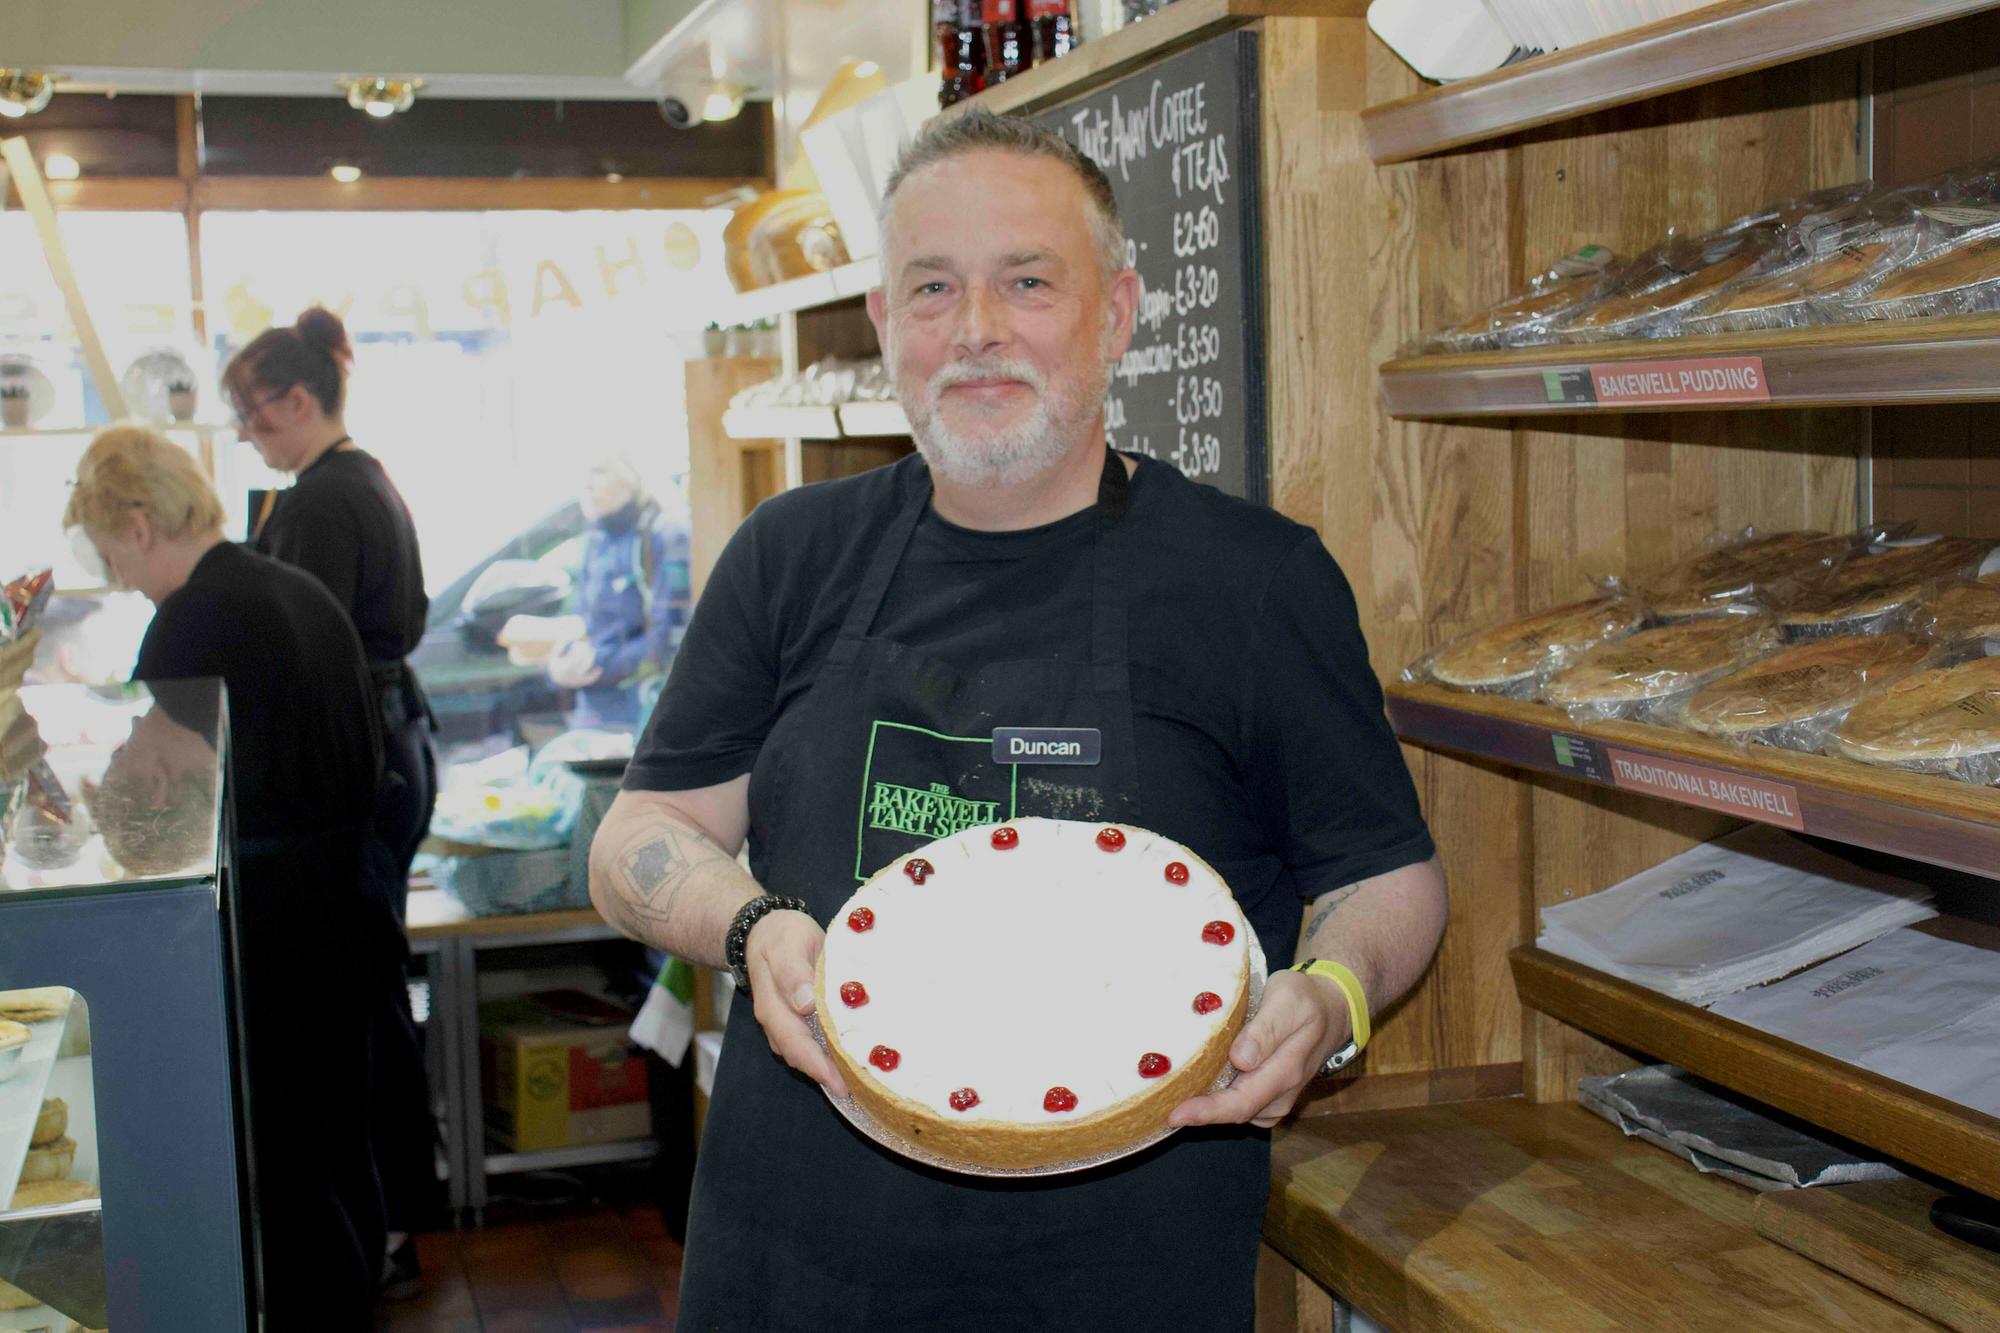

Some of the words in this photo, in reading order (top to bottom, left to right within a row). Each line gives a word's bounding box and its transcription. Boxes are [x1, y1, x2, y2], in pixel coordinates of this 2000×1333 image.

[1150, 79, 1208, 149] COFFEE
[1182, 134, 1231, 204] TEAS
[1599, 372, 1680, 397] BAKEWELL
[1680, 366, 1760, 393] PUDDING
[1010, 737, 1081, 756] Duncan
[873, 785, 1003, 824] BAKEWELL
[930, 782, 951, 795] THE
[1615, 758, 1709, 796] TRADITIONAL
[1709, 780, 1794, 817] BAKEWELL
[869, 804, 933, 834] TART
[933, 816, 984, 838] SH
